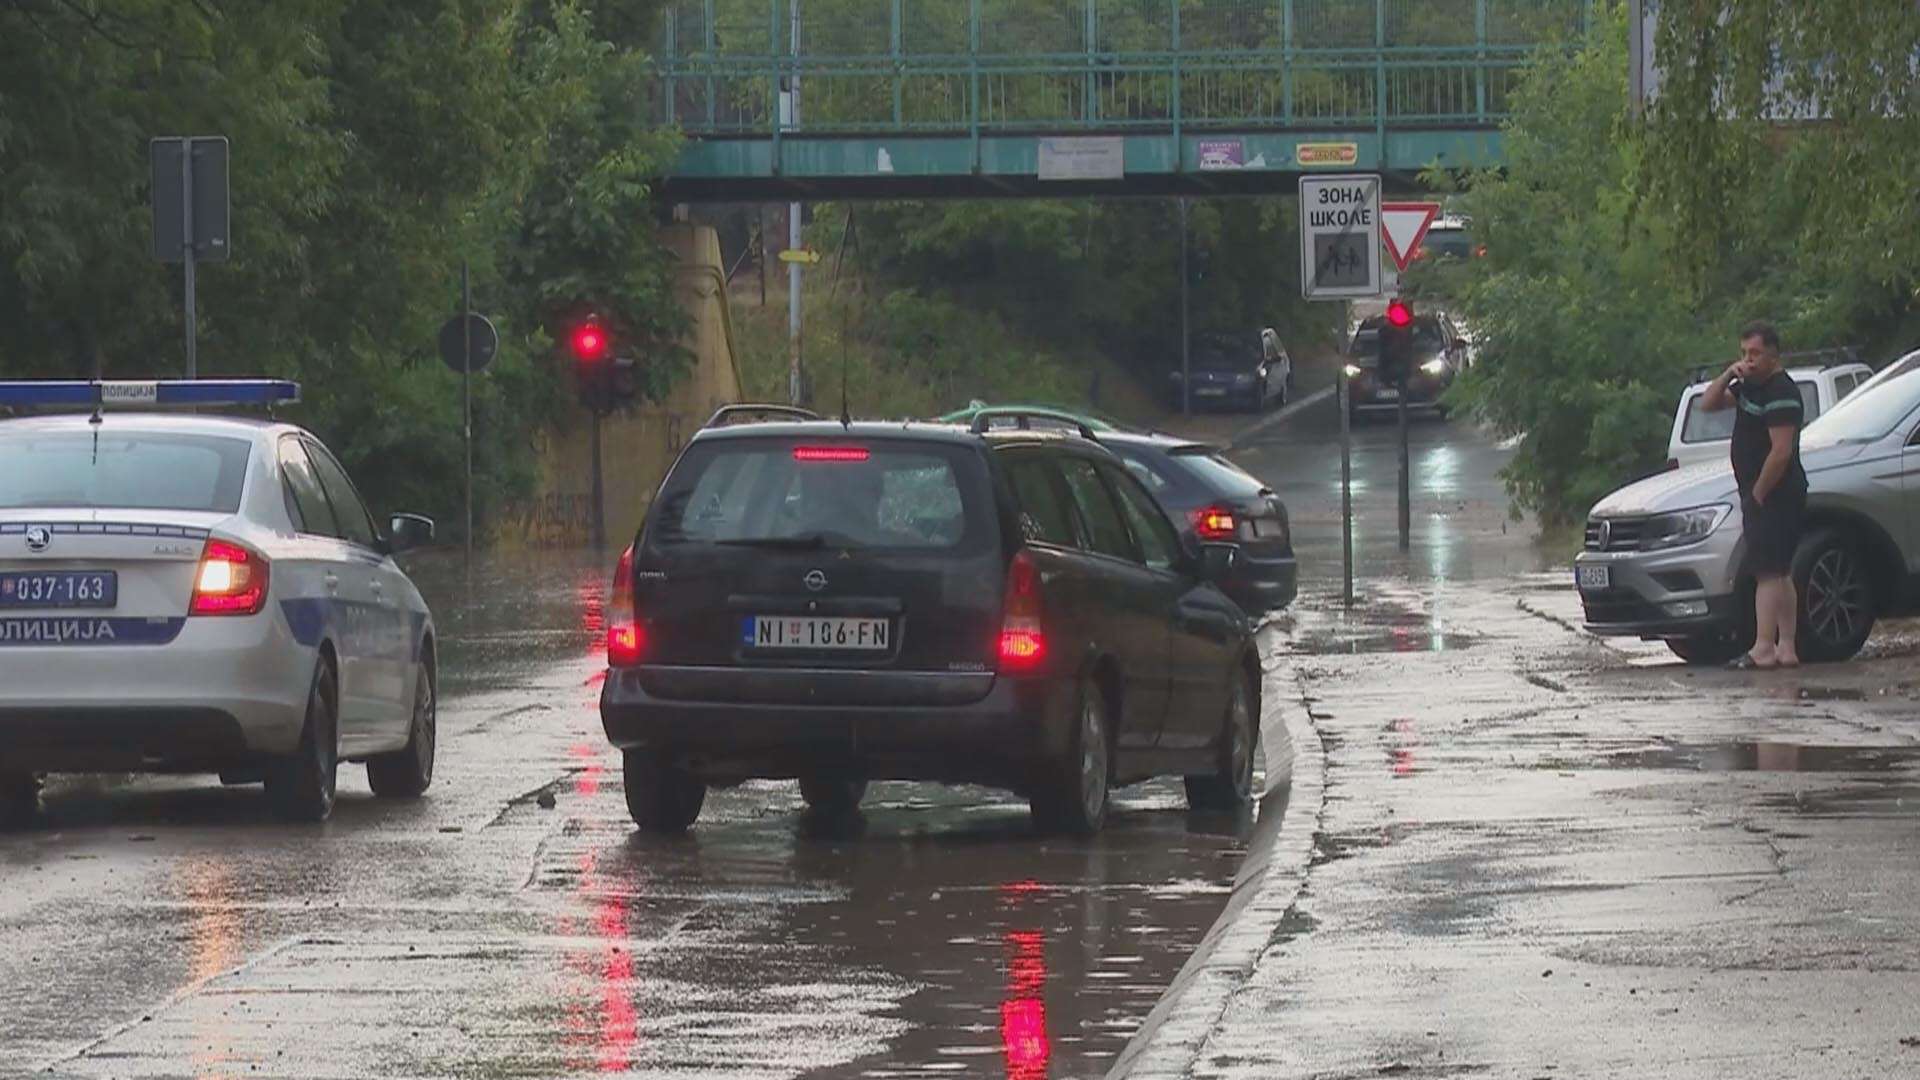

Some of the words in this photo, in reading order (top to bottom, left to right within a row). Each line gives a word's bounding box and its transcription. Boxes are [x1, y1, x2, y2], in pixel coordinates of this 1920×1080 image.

[1318, 187, 1364, 204] ЗОНА
[1310, 209, 1372, 227] ШКОЛЕ
[0, 620, 115, 642] ЛИЦИЈА
[759, 620, 783, 644] NI
